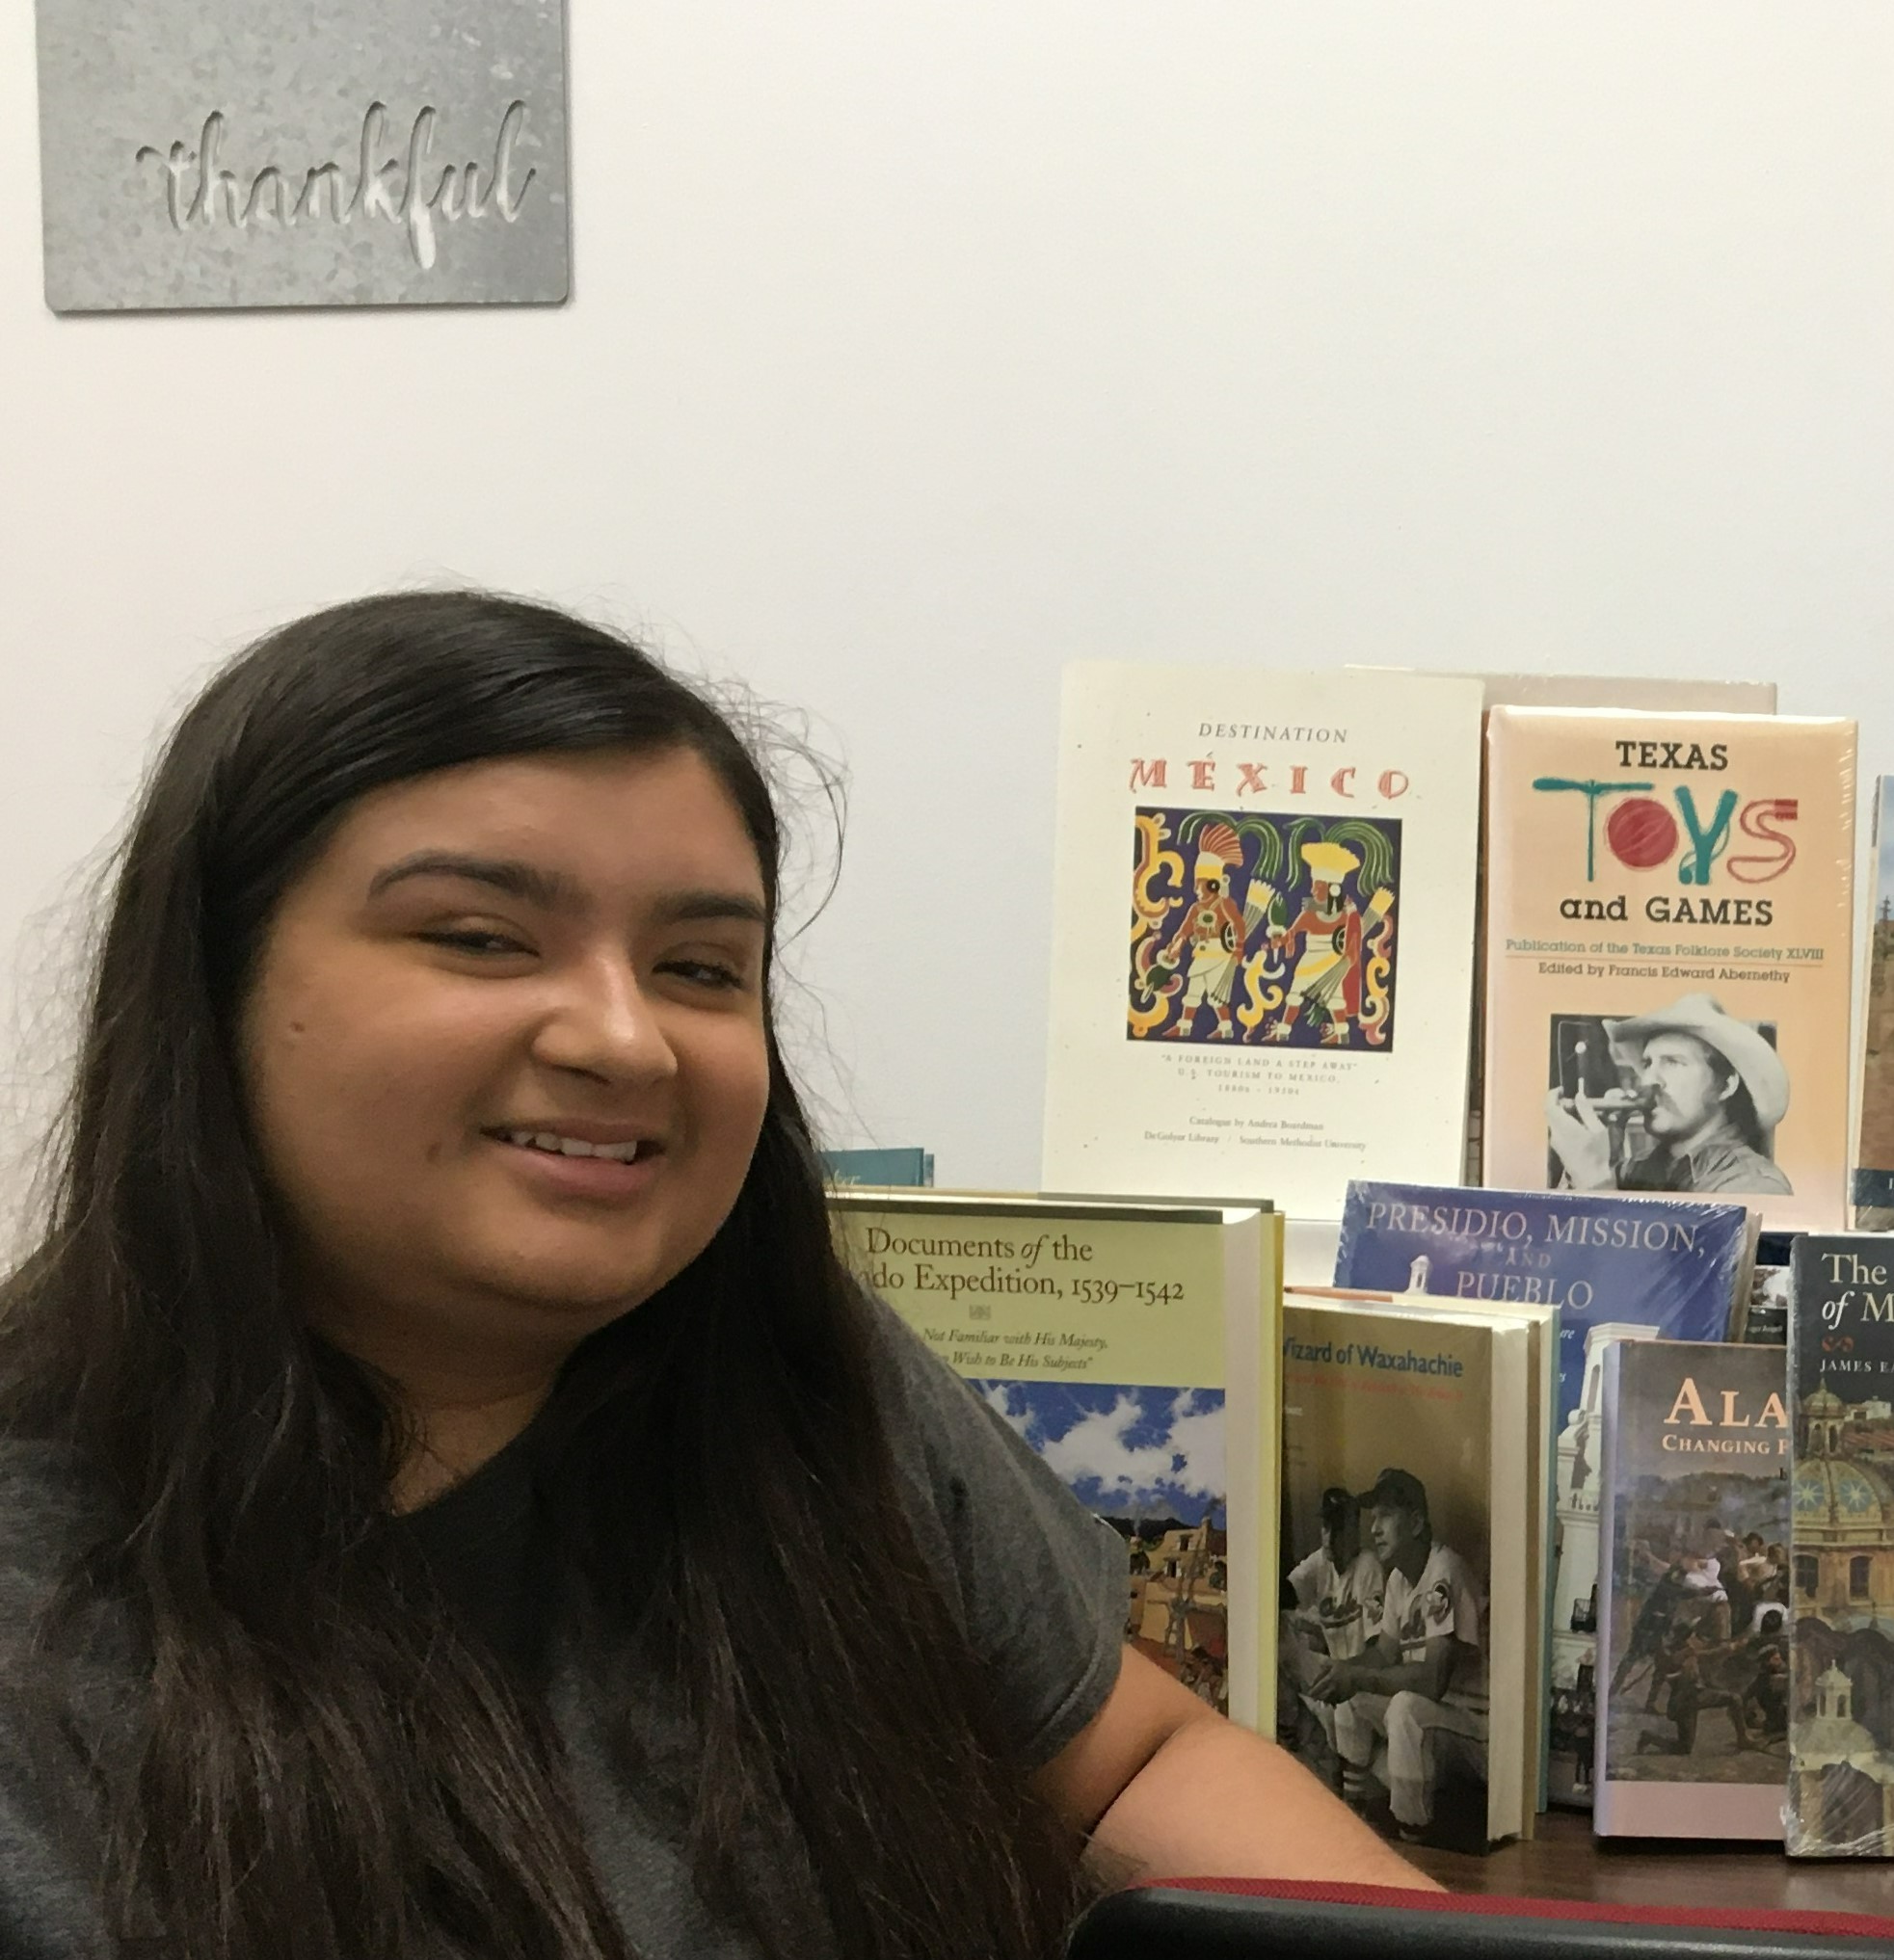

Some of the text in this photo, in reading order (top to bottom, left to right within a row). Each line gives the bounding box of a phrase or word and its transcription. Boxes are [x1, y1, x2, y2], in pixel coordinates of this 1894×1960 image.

[134, 99, 536, 270] thankful
[1198, 723, 1347, 743] DESTINATION
[1615, 740, 1728, 771] TEXAS
[1130, 752, 1409, 799] MÉXICO
[1533, 777, 1799, 886] TOYS
[1560, 895, 1774, 926] and GAMES
[1506, 939, 1824, 961] Publication of the Texas Folklore Society XLVIII
[1538, 962, 1791, 984] Edited by Francis Edward Abernethy
[1178, 1055, 1232, 1065] FOREIGN
[1238, 1058, 1269, 1068] LAND
[1289, 1060, 1316, 1069] STEP
[1207, 1069, 1261, 1080] TOURISM
[1267, 1072, 1283, 1080] TO
[1235, 1118, 1244, 1128] by
[1247, 1119, 1278, 1129] Andrea
[1188, 1132, 1219, 1144] Library
[1240, 1135, 1276, 1146] Southern
[1324, 1139, 1367, 1152] University
[1366, 1203, 1705, 1258] PRESIDIO, MISSION,
[866, 1227, 1093, 1268] Documents of the
[1506, 1248, 1552, 1269] AND
[915, 1263, 1062, 1300] Expedition,
[1821, 1253, 1888, 1285] The
[1457, 1271, 1593, 1310] PUEBLO
[1822, 1291, 1855, 1330] of
[924, 1328, 1108, 1351] Not Familiar with His Majesty,
[952, 1351, 982, 1364] Wish
[985, 1355, 996, 1364] to
[1000, 1353, 1015, 1366] Be
[1018, 1354, 1039, 1367] His
[1336, 1344, 1353, 1364] of
[1357, 1344, 1463, 1378] Waxahachie
[1820, 1359, 1872, 1372] JAMES
[1662, 1434, 1770, 1455] CHANGING
